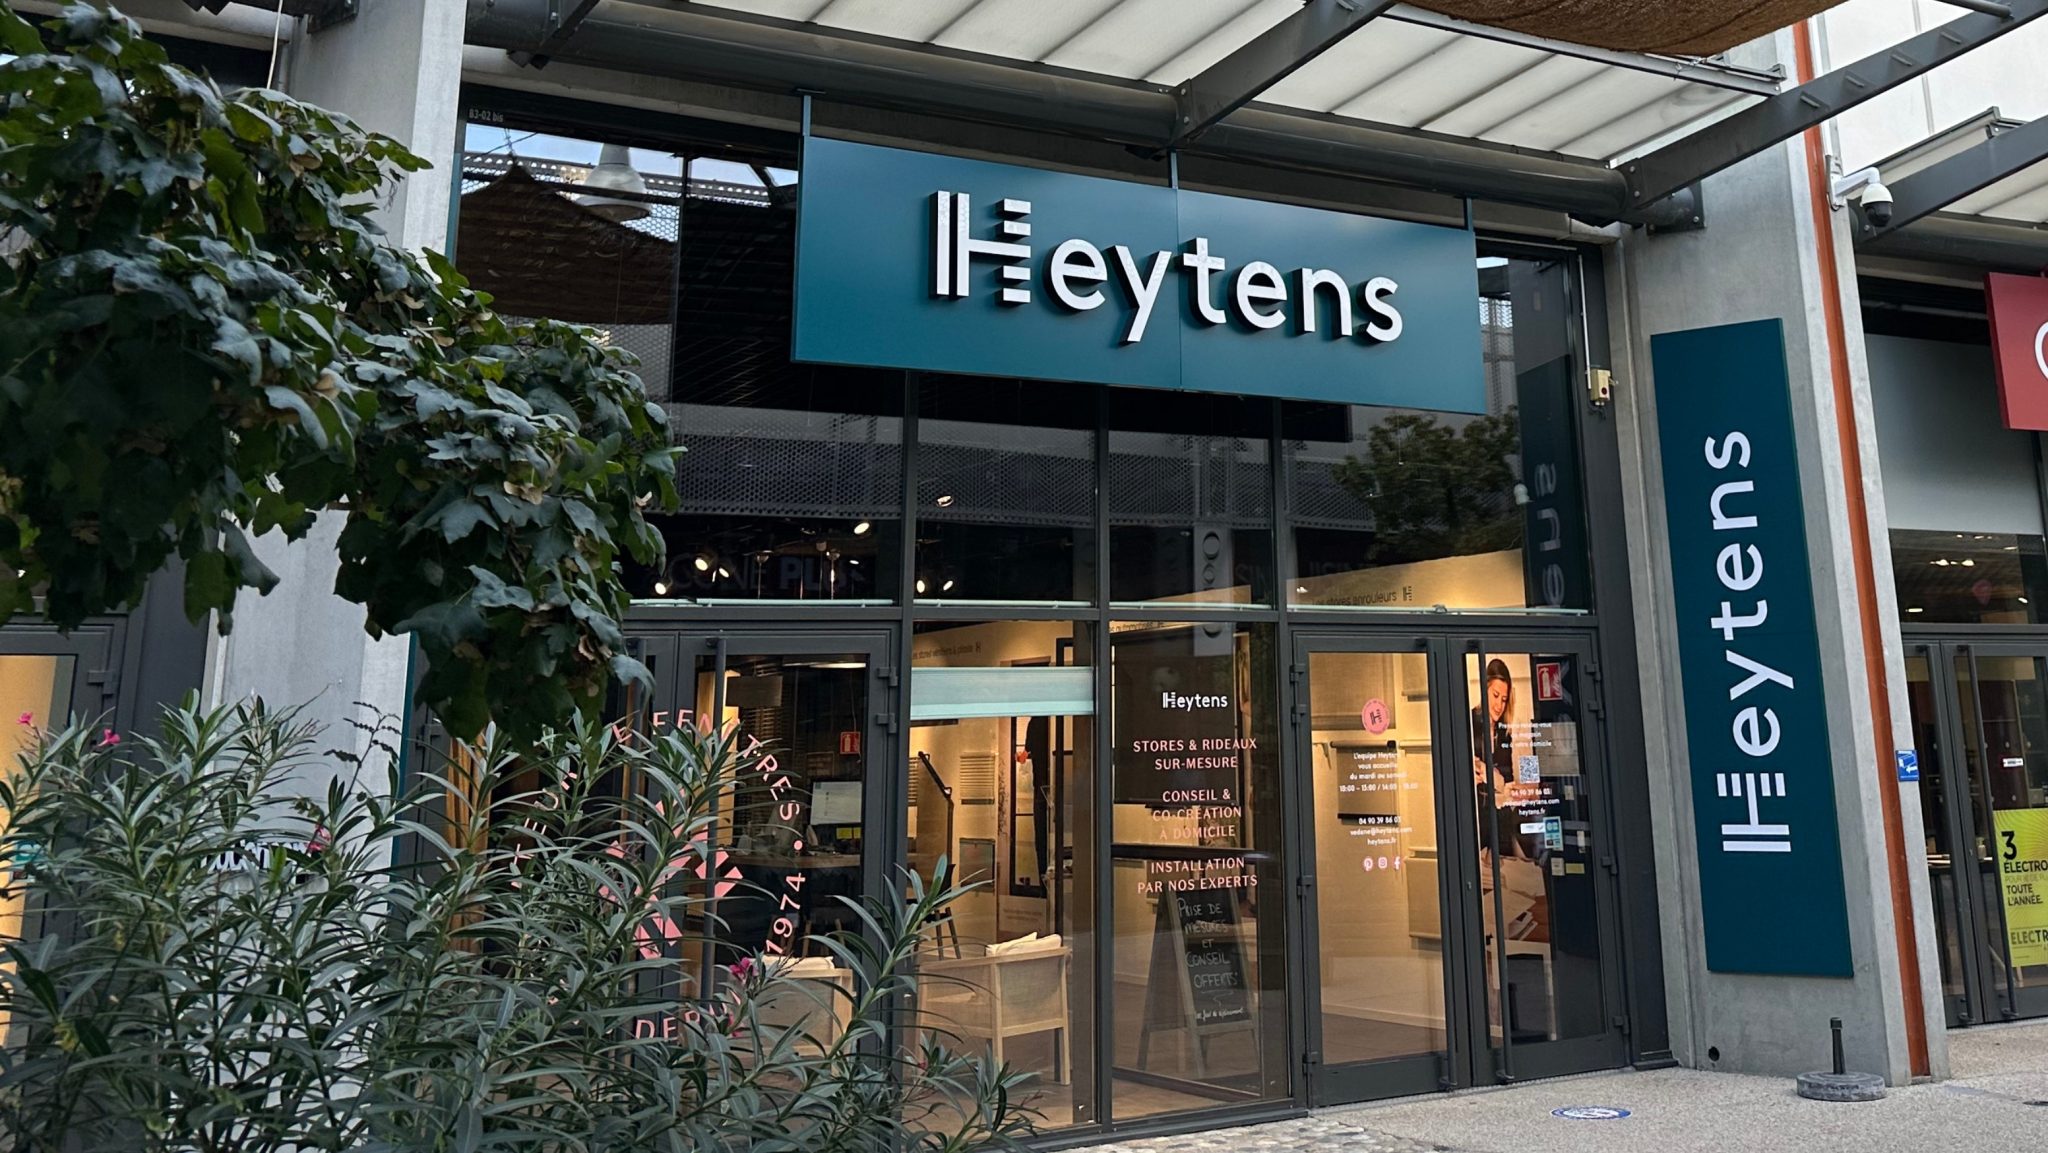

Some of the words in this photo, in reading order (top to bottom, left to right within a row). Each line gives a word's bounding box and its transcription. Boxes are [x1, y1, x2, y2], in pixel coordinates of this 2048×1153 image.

[492, 112, 504, 122] bis
[935, 190, 1403, 343] Heytens
[1704, 430, 1794, 853] Heytens
[1163, 692, 1228, 712] Heytens
[1133, 740, 1184, 753] STORES
[1189, 740, 1197, 751] &
[1202, 738, 1257, 751] RIDEAUX
[1155, 756, 1238, 770] SUR-MESURE
[1163, 789, 1217, 802] CONSEIL
[1222, 789, 1231, 800] &
[1519, 808, 1545, 817] heytens.fr
[1173, 825, 1236, 839] DOMICILE
[2001, 830, 2017, 861] 3
[1151, 857, 1245, 874] INSTALLATION
[1138, 882, 1163, 894] PAR
[1168, 879, 1195, 891] NOS
[1200, 875, 1258, 889] EXPERTS
[2006, 884, 2033, 895] TOUTE
[765, 872, 806, 956] 1974
[1202, 939, 1214, 948] ET
